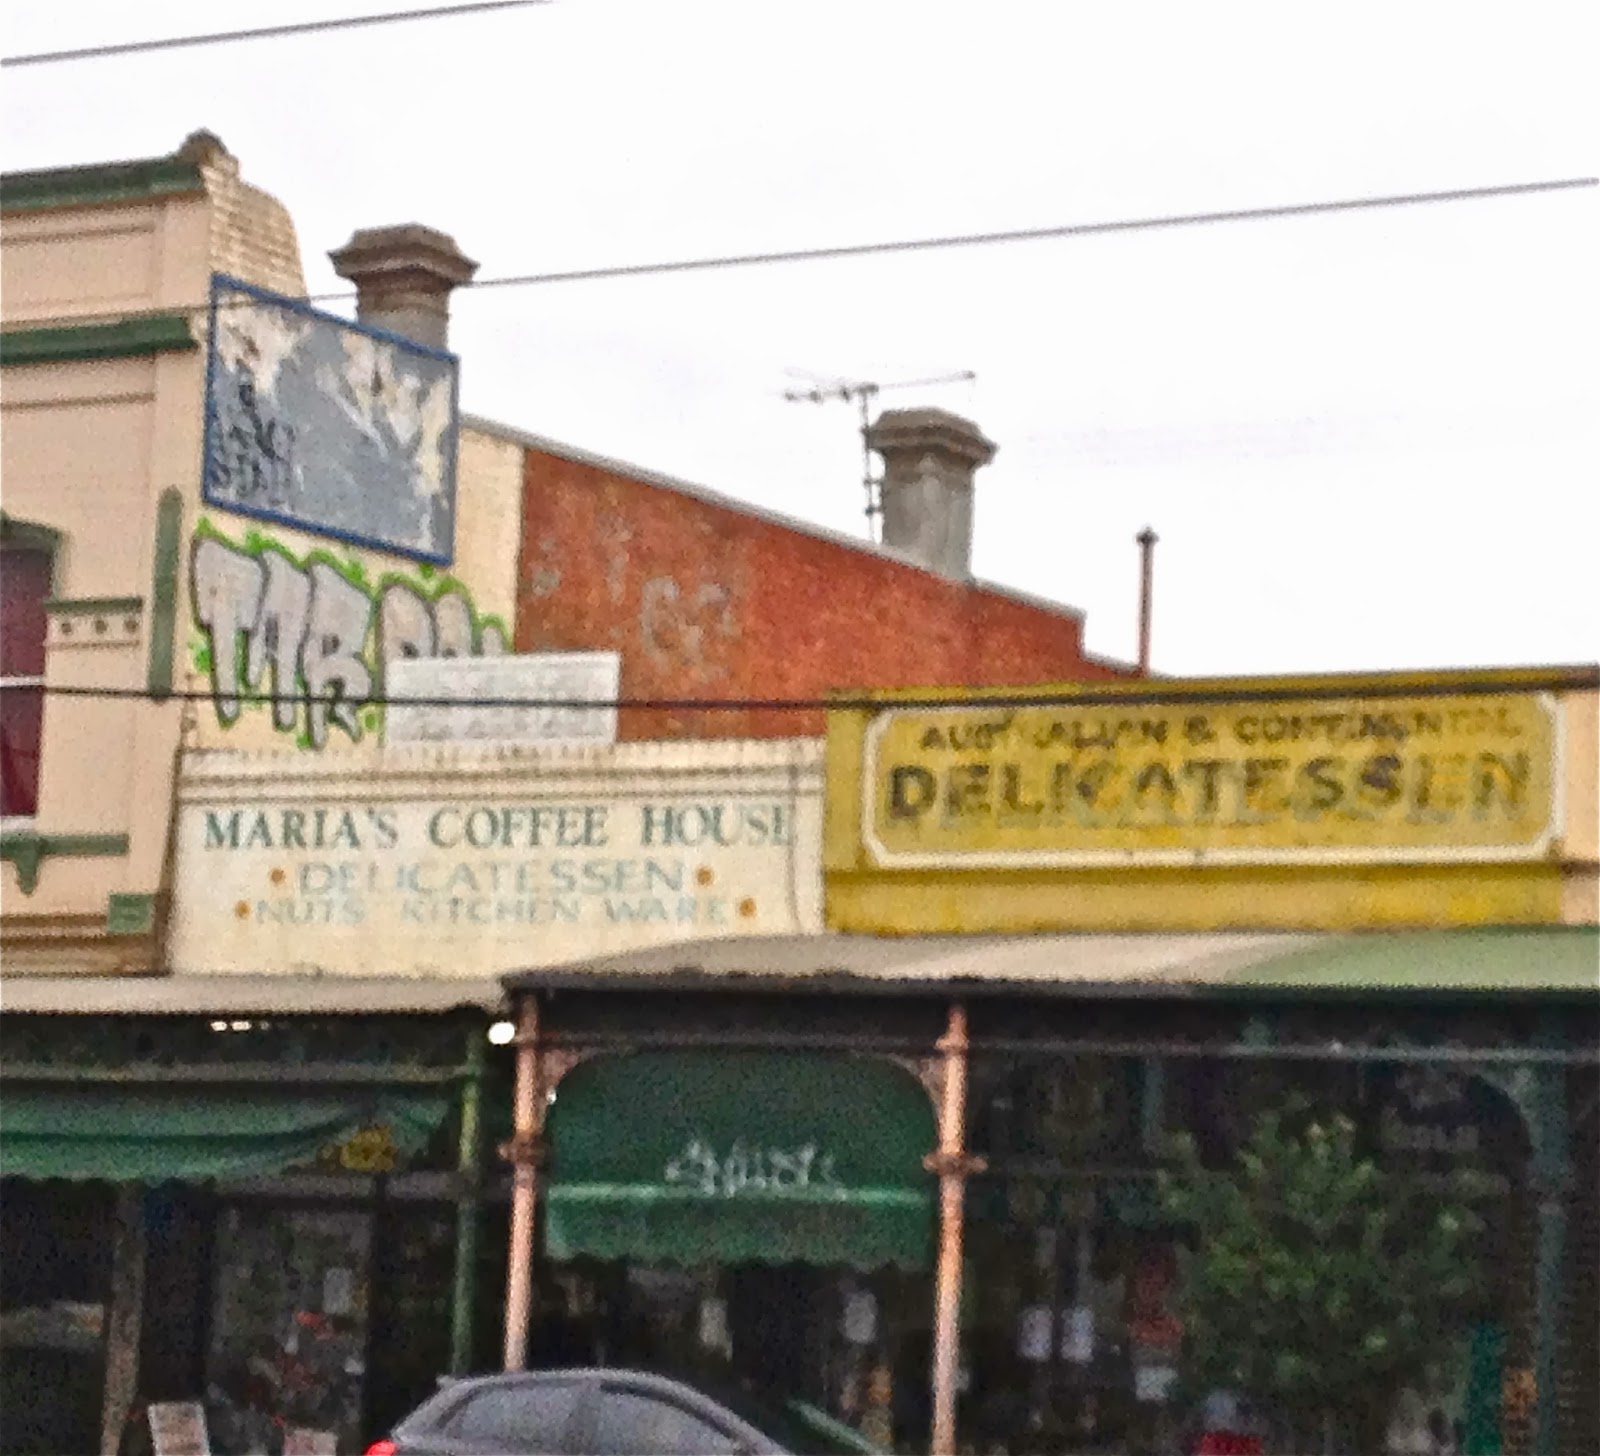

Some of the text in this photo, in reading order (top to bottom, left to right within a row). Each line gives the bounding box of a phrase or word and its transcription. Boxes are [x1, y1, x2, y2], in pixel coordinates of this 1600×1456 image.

[888, 750, 1532, 824] DELICATESSEN
[204, 803, 789, 850] MARIA'S COFFEE HOUSE
[300, 857, 684, 895] DELICATESSEN
[254, 896, 730, 925] NUTS KITCHEN WARE
